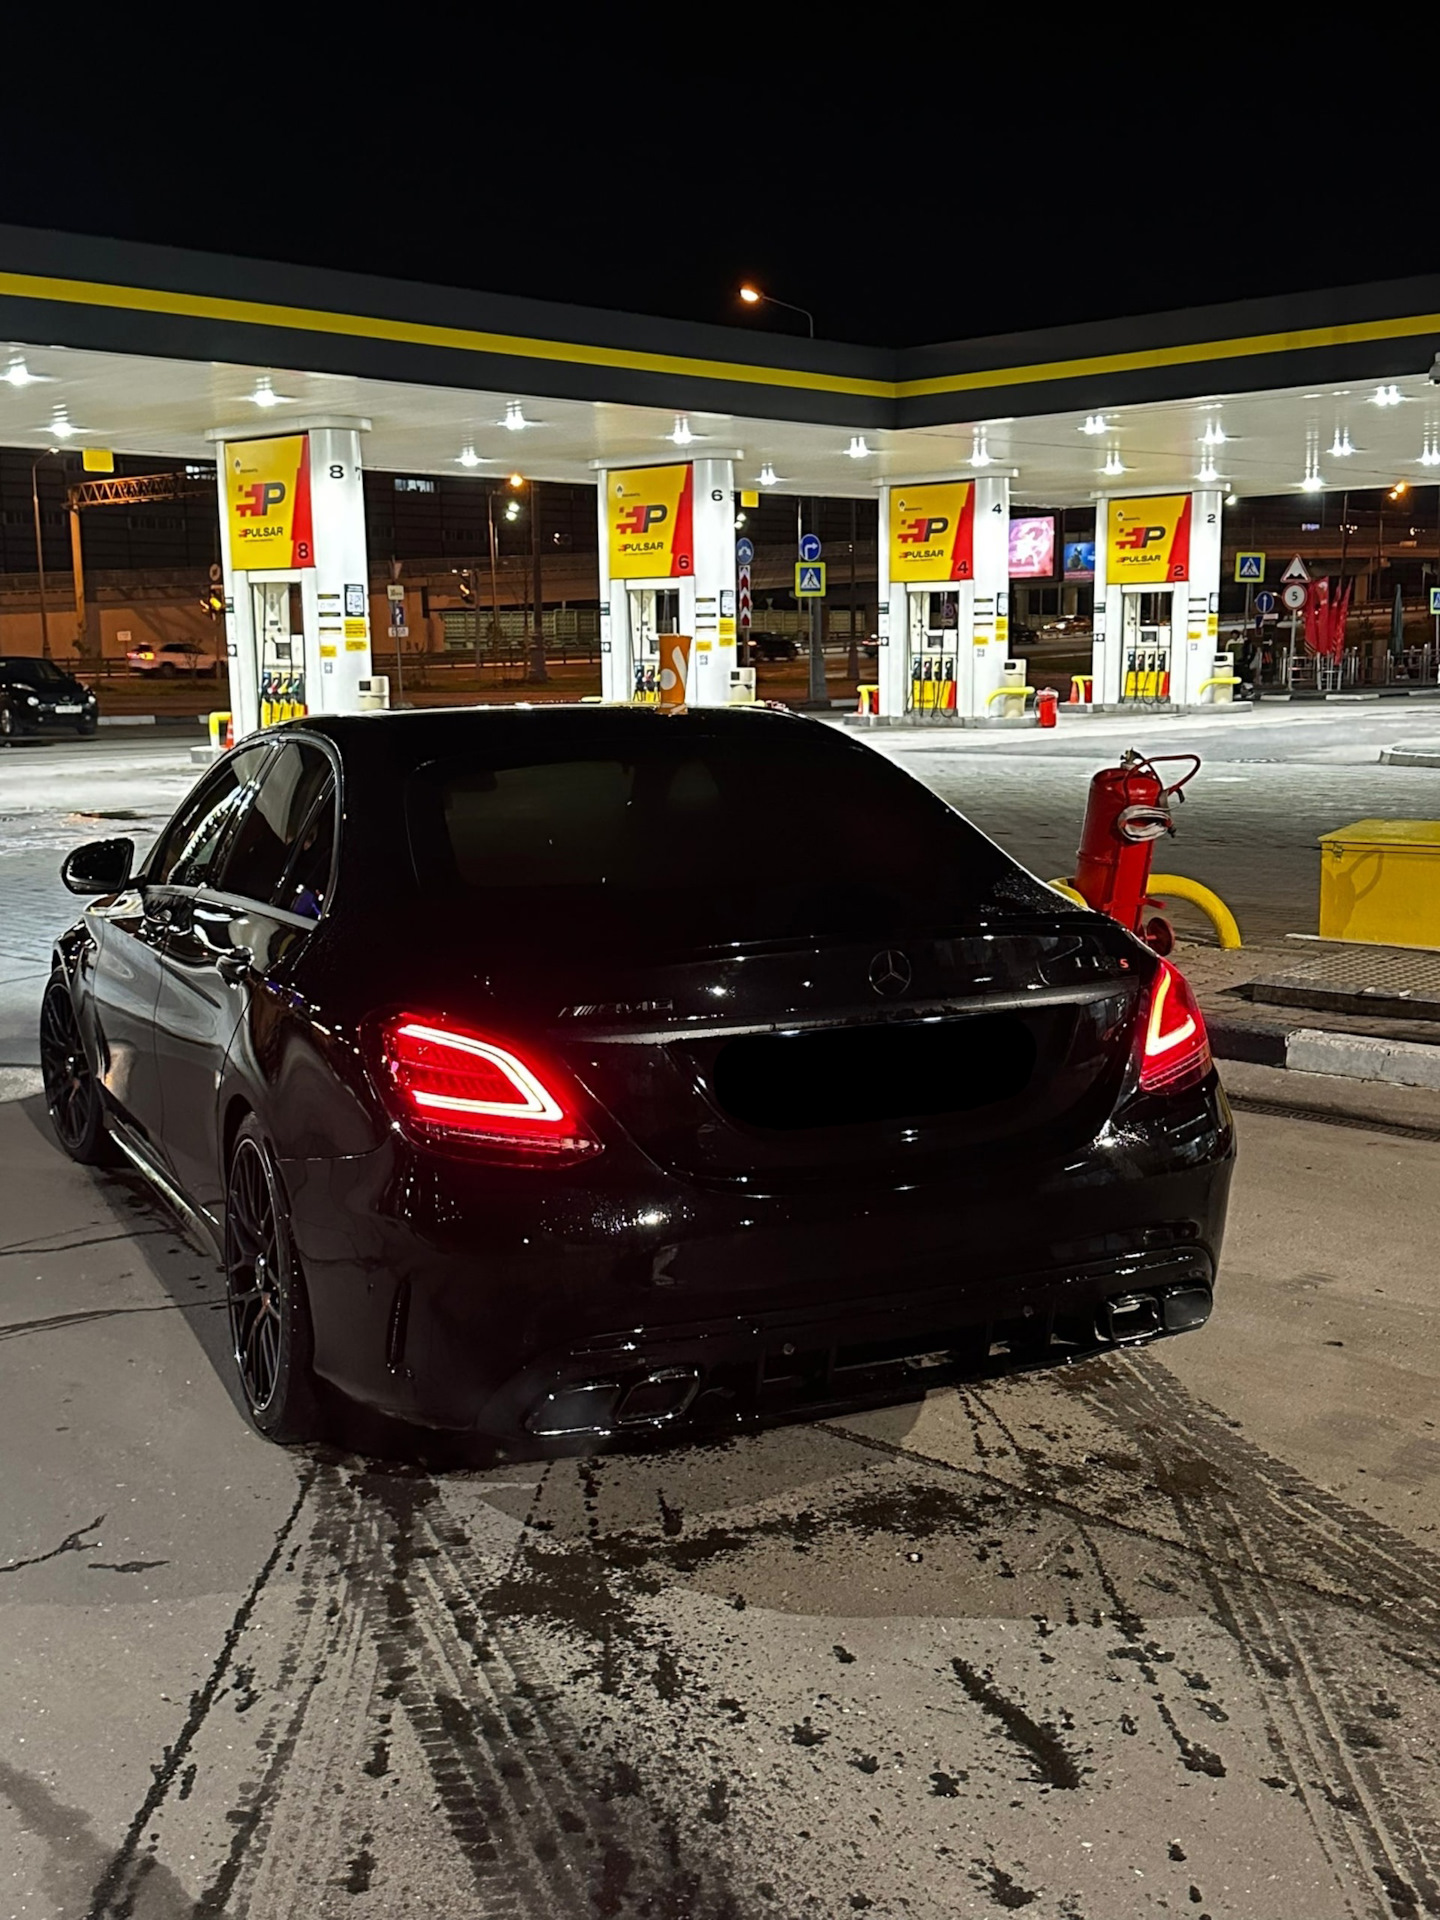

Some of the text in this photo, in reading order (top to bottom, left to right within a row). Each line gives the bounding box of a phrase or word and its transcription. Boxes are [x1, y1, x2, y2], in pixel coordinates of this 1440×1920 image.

[329, 465, 344, 479] 8
[711, 489, 723, 501] 6
[992, 503, 1002, 514] 4
[1207, 513, 1216, 523] 2
[246, 526, 283, 537] PULSAR
[298, 542, 309, 559] 8
[625, 541, 664, 552] PULSAR
[907, 550, 944, 558] PULSAR
[1122, 555, 1161, 563] PULSAR
[678, 555, 690, 569] 6
[957, 561, 968, 574] 4
[1174, 565, 1184, 577] 2
[1291, 591, 1298, 602] 5
